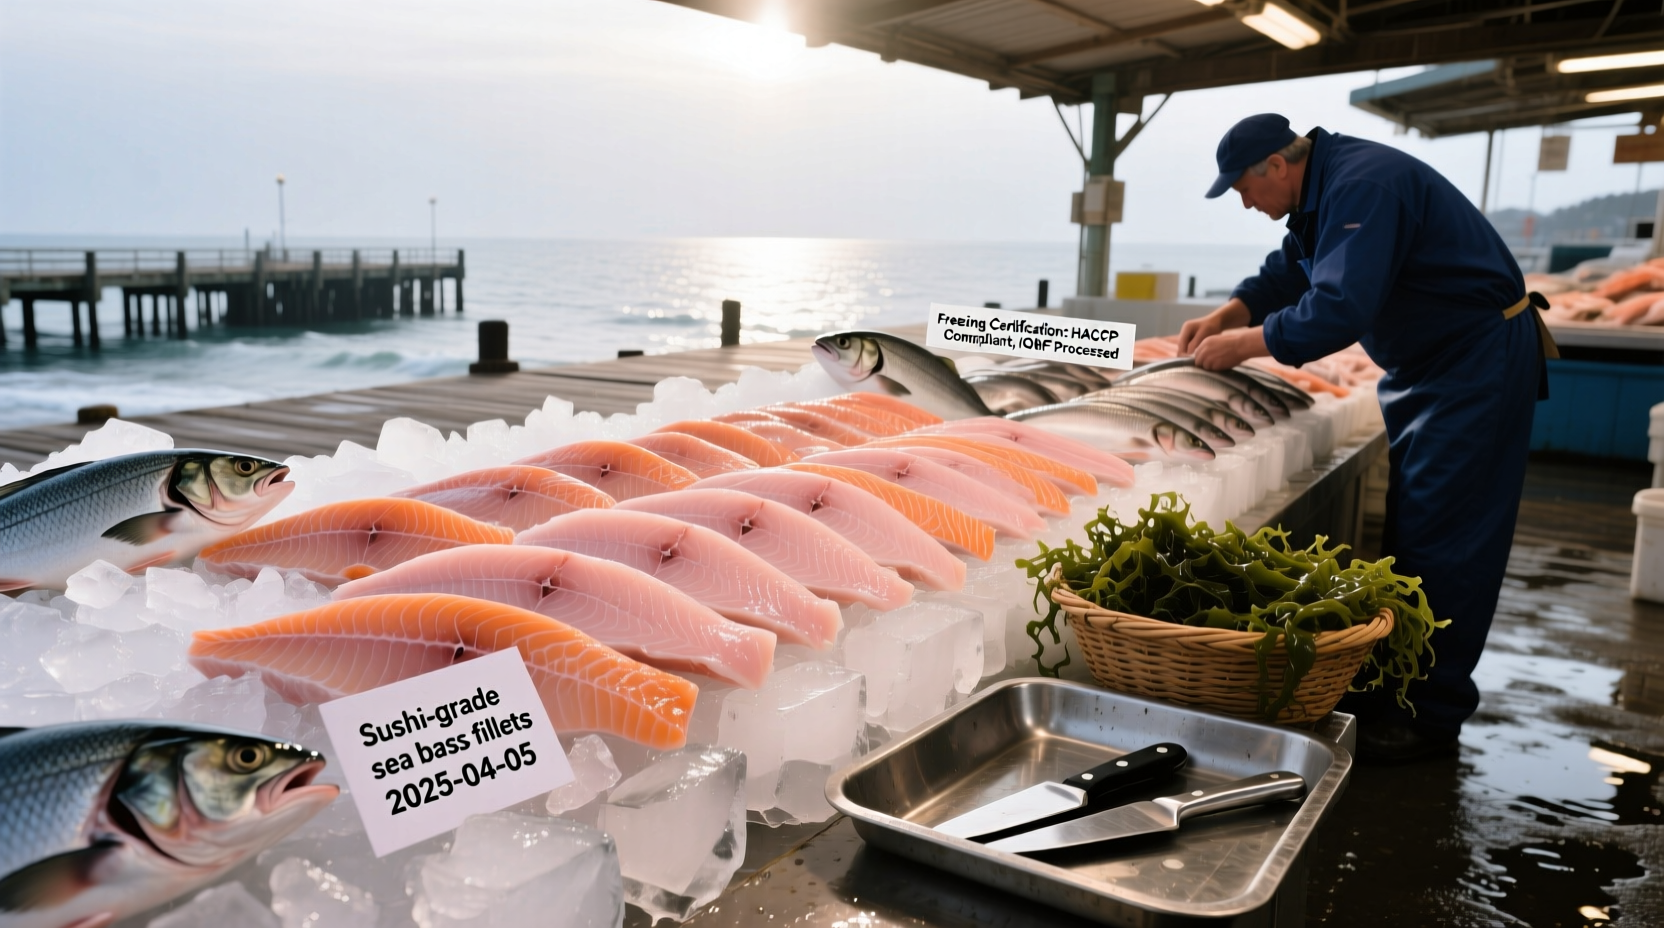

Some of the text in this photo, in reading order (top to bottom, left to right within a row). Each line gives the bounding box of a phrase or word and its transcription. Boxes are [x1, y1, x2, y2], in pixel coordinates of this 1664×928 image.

[1071, 326, 1119, 343] HACCP
[359, 686, 501, 747] Sushi-grade
[371, 712, 533, 780] sea bass fillets
[385, 741, 538, 816] 2025-04-05
